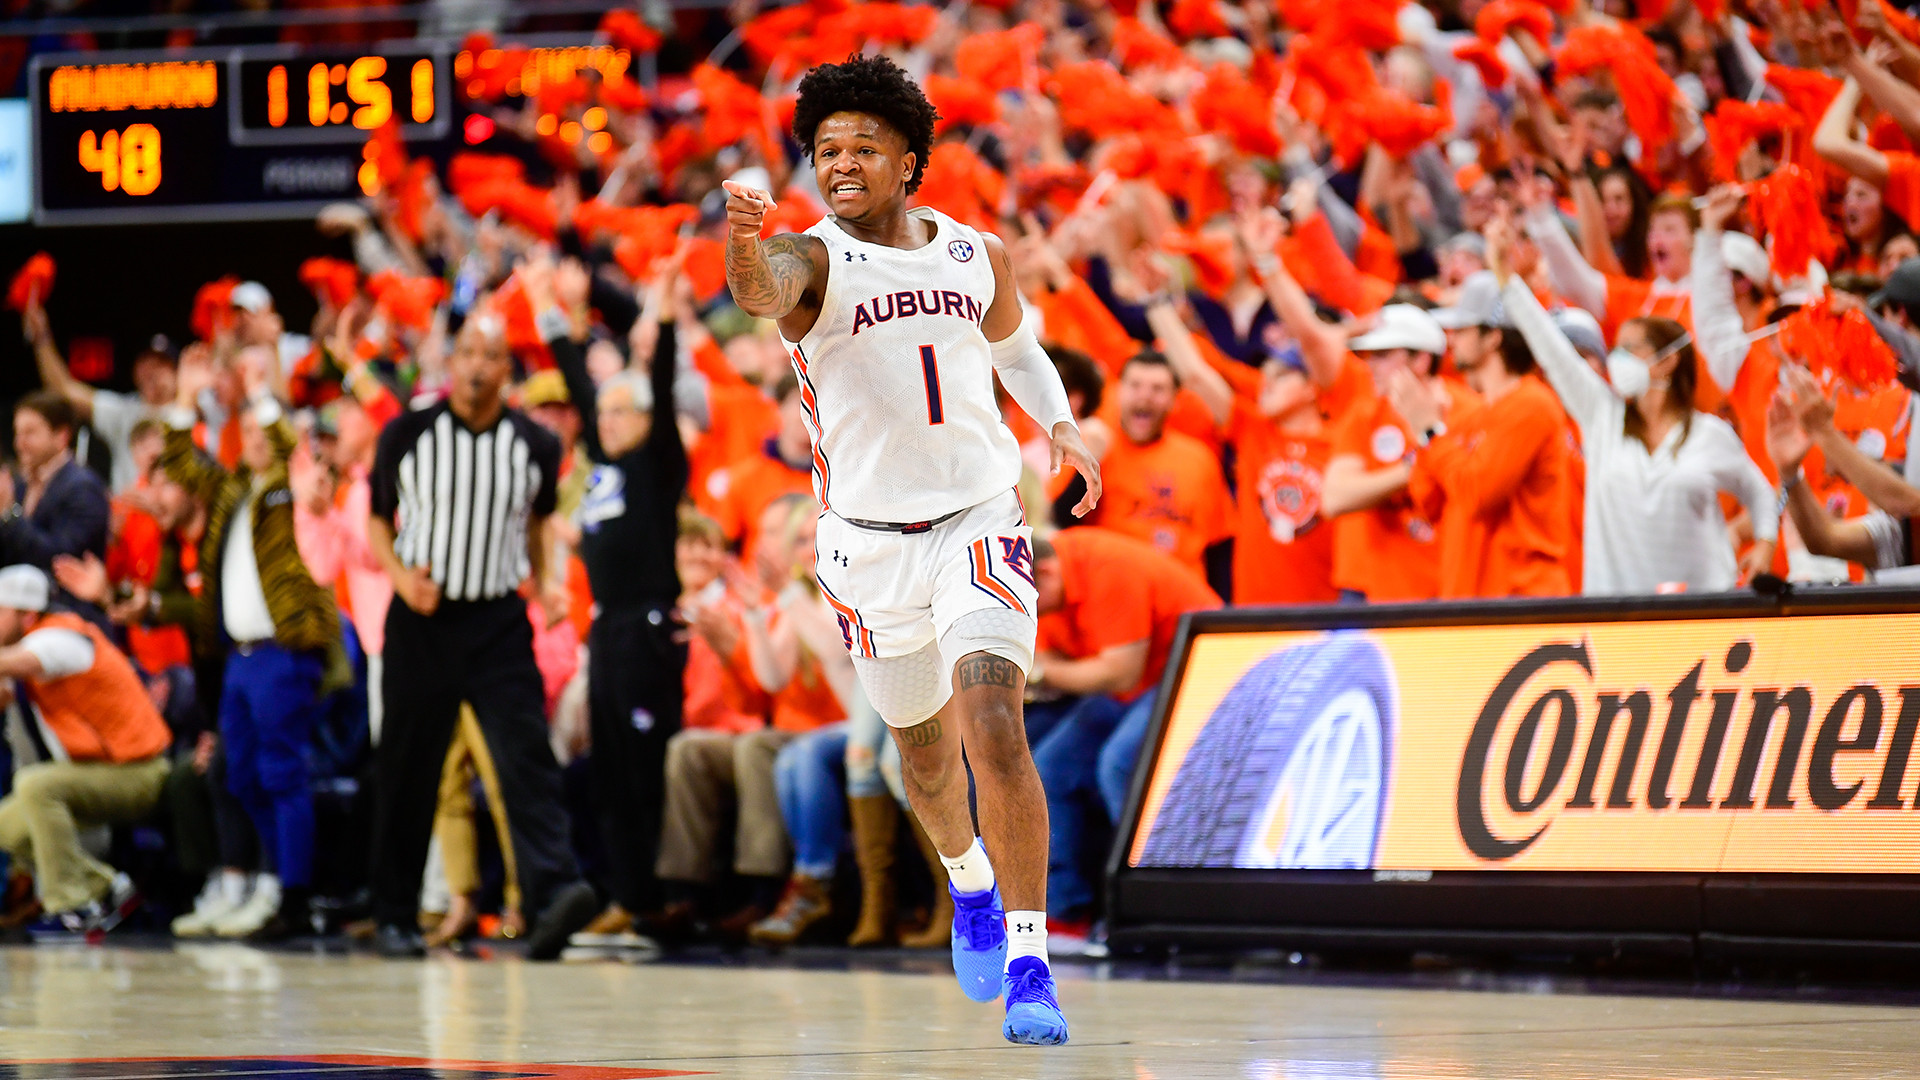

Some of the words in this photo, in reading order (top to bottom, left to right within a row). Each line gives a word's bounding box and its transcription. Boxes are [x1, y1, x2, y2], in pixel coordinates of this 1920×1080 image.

[267, 56, 434, 129] 11:51
[79, 123, 161, 195] 48
[949, 240, 973, 262] SEC
[852, 290, 982, 336] AUBURN
[918, 344, 944, 425] 1
[960, 661, 1016, 688] FIRST
[901, 721, 941, 745] GOD
